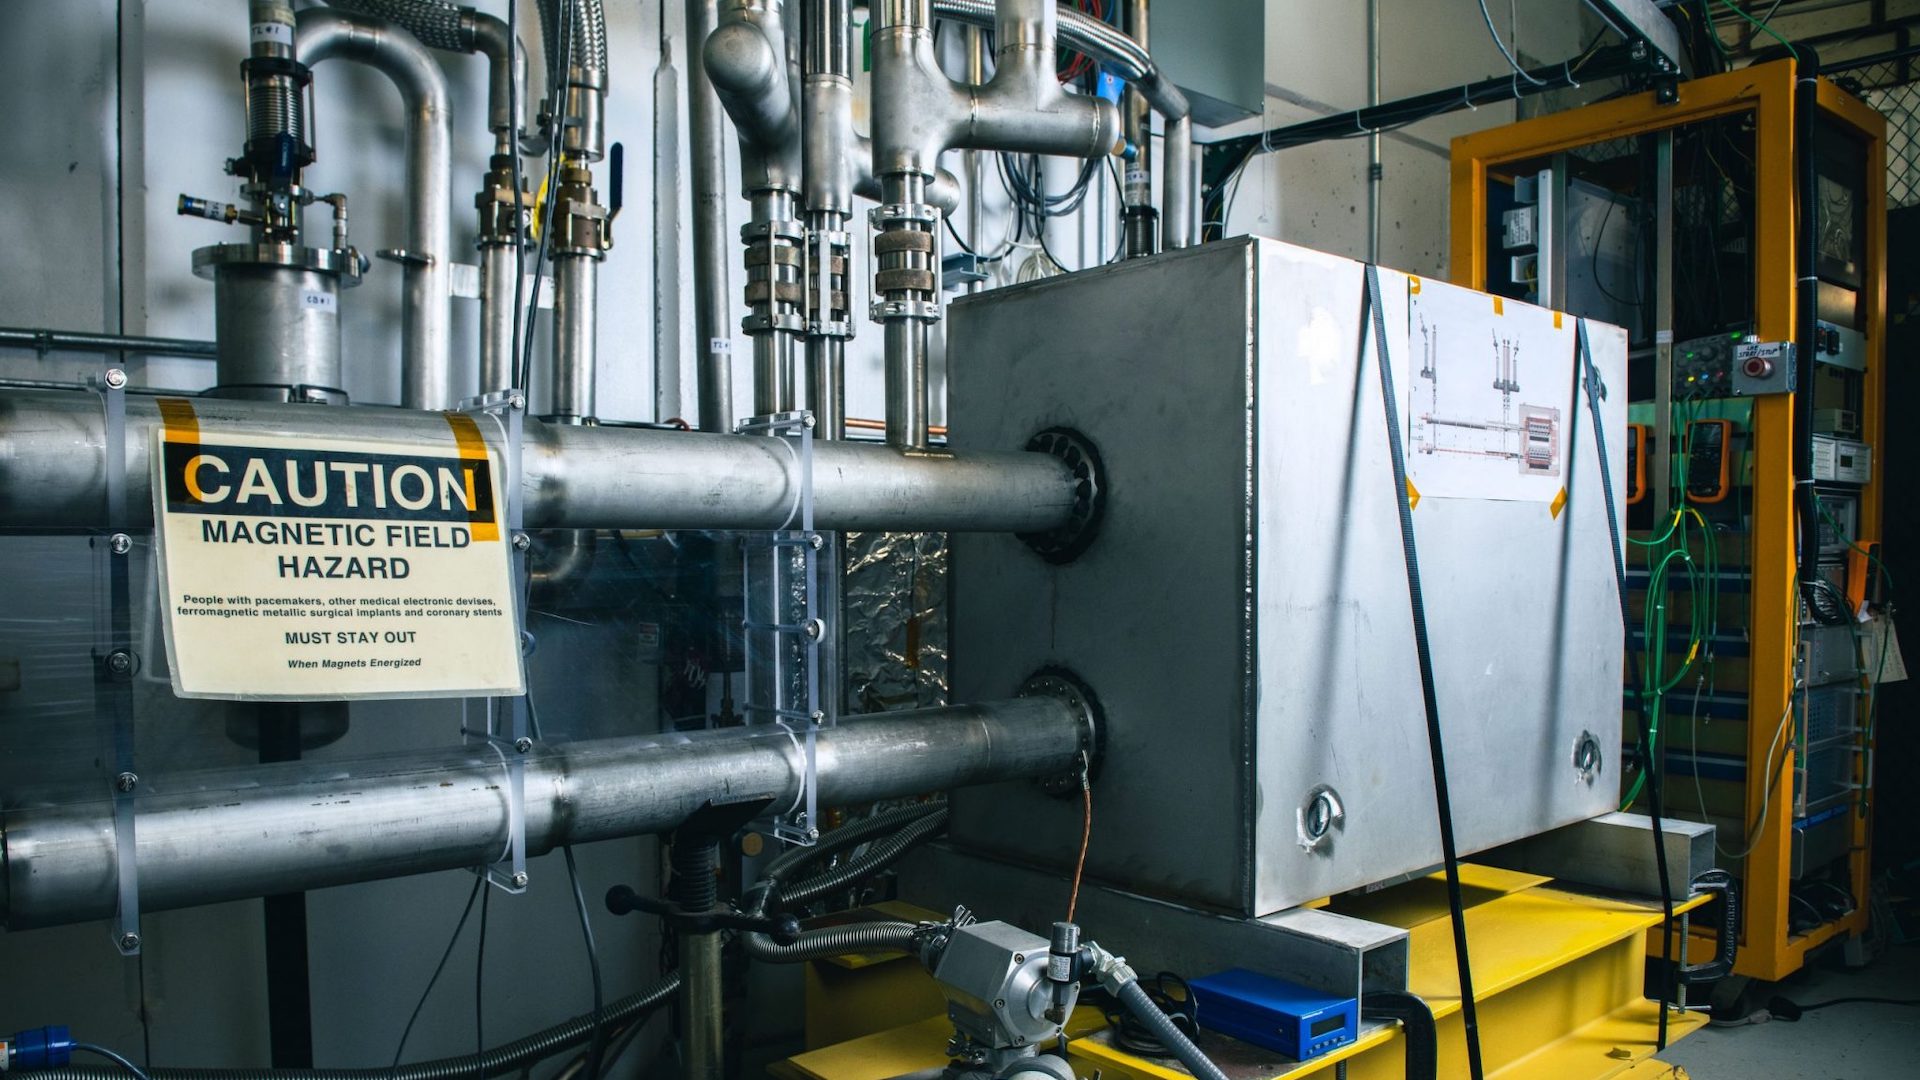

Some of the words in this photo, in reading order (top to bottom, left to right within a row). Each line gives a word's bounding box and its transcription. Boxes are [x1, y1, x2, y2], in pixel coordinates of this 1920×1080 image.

[184, 454, 477, 512] CAUTION
[202, 518, 377, 548] MAGNETIC
[386, 523, 471, 548] FIELD
[277, 554, 411, 580] HAZARD
[183, 594, 223, 606] People
[227, 595, 251, 605] with
[255, 597, 326, 608] pacemakers,
[328, 597, 356, 606] other
[359, 597, 401, 606] medical
[403, 597, 454, 606] electronic
[455, 597, 496, 607] devises,
[177, 606, 259, 618] ferromagnetic
[262, 607, 307, 618] metallic
[310, 608, 353, 619] surgical
[356, 608, 401, 619] implants
[404, 608, 424, 617] and
[426, 608, 471, 619] coronary
[472, 608, 503, 617] stents
[285, 631, 331, 645] MUST
[337, 631, 379, 644] STAY
[384, 631, 416, 644] OUT
[288, 659, 318, 669] When
[321, 658, 367, 670] Magnets
[370, 657, 422, 668] Energized
